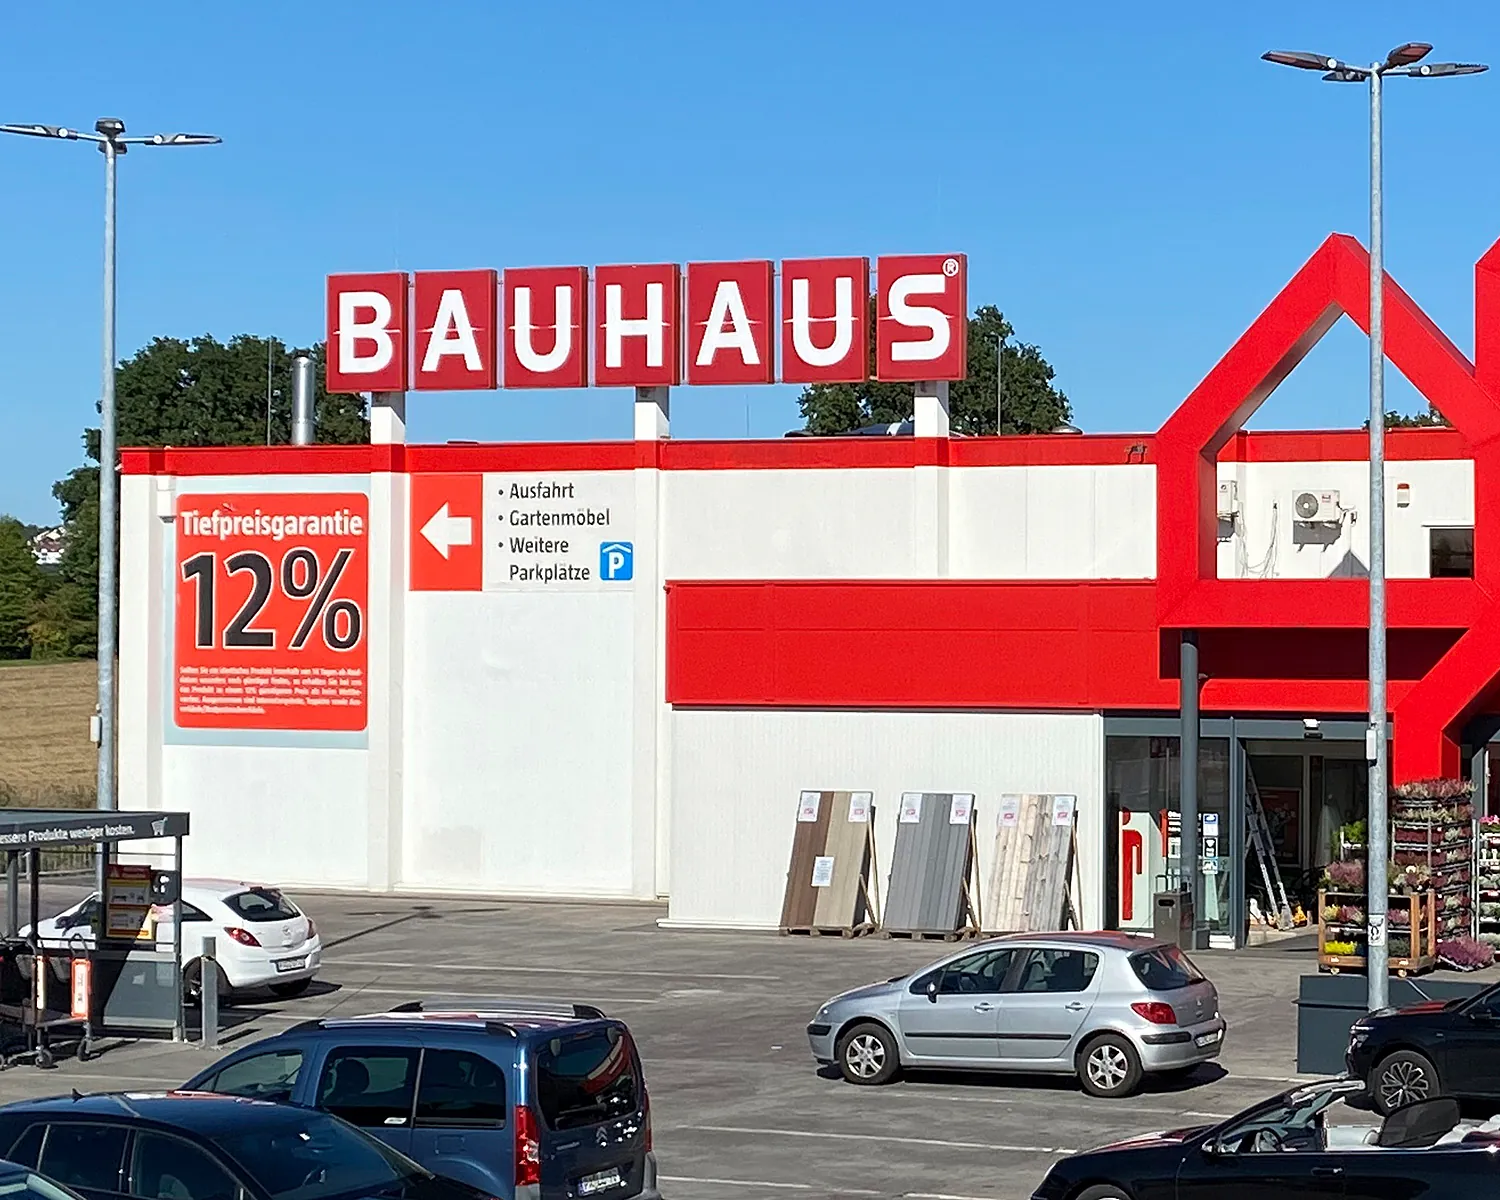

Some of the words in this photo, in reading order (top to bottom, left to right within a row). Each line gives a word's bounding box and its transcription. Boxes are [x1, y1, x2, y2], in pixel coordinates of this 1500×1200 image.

[337, 274, 951, 374] BAUHAUS
[509, 481, 574, 499] Ausfahrt
[180, 509, 363, 541] Tiefpreisgarantie
[509, 508, 610, 526] Gartenmöbel
[509, 536, 569, 553] Weitere
[509, 563, 590, 584] Parkplätze
[609, 552, 624, 578] P
[181, 546, 363, 652] 12%
[28, 828, 68, 841] Produkte
[69, 826, 104, 839] weniger
[105, 824, 135, 837] kosten.
